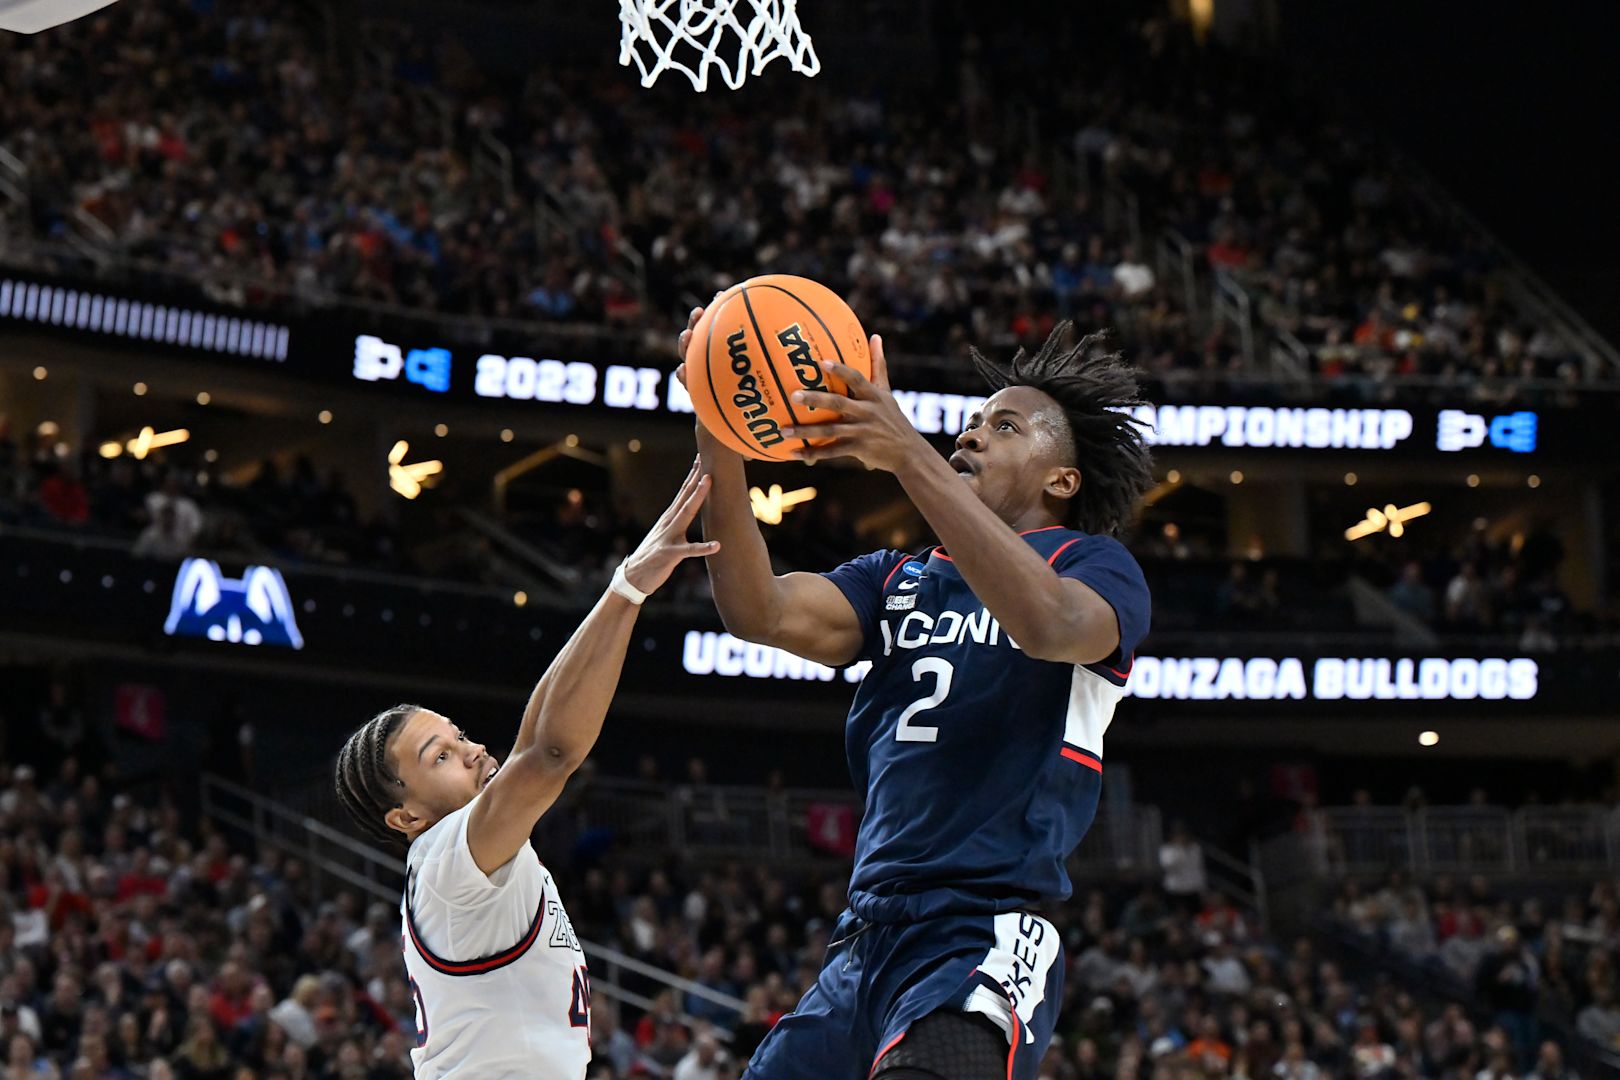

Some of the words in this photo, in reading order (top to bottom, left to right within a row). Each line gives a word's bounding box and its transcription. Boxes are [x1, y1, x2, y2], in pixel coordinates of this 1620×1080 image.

[475, 354, 597, 405] 2023
[603, 365, 661, 410] DI
[1104, 404, 1413, 449] AMPIONSHIP
[727, 329, 785, 448] Wilson
[896, 657, 954, 742] 2
[1126, 656, 1307, 700] ONZAGA
[1313, 657, 1539, 700] BULLDOGS
